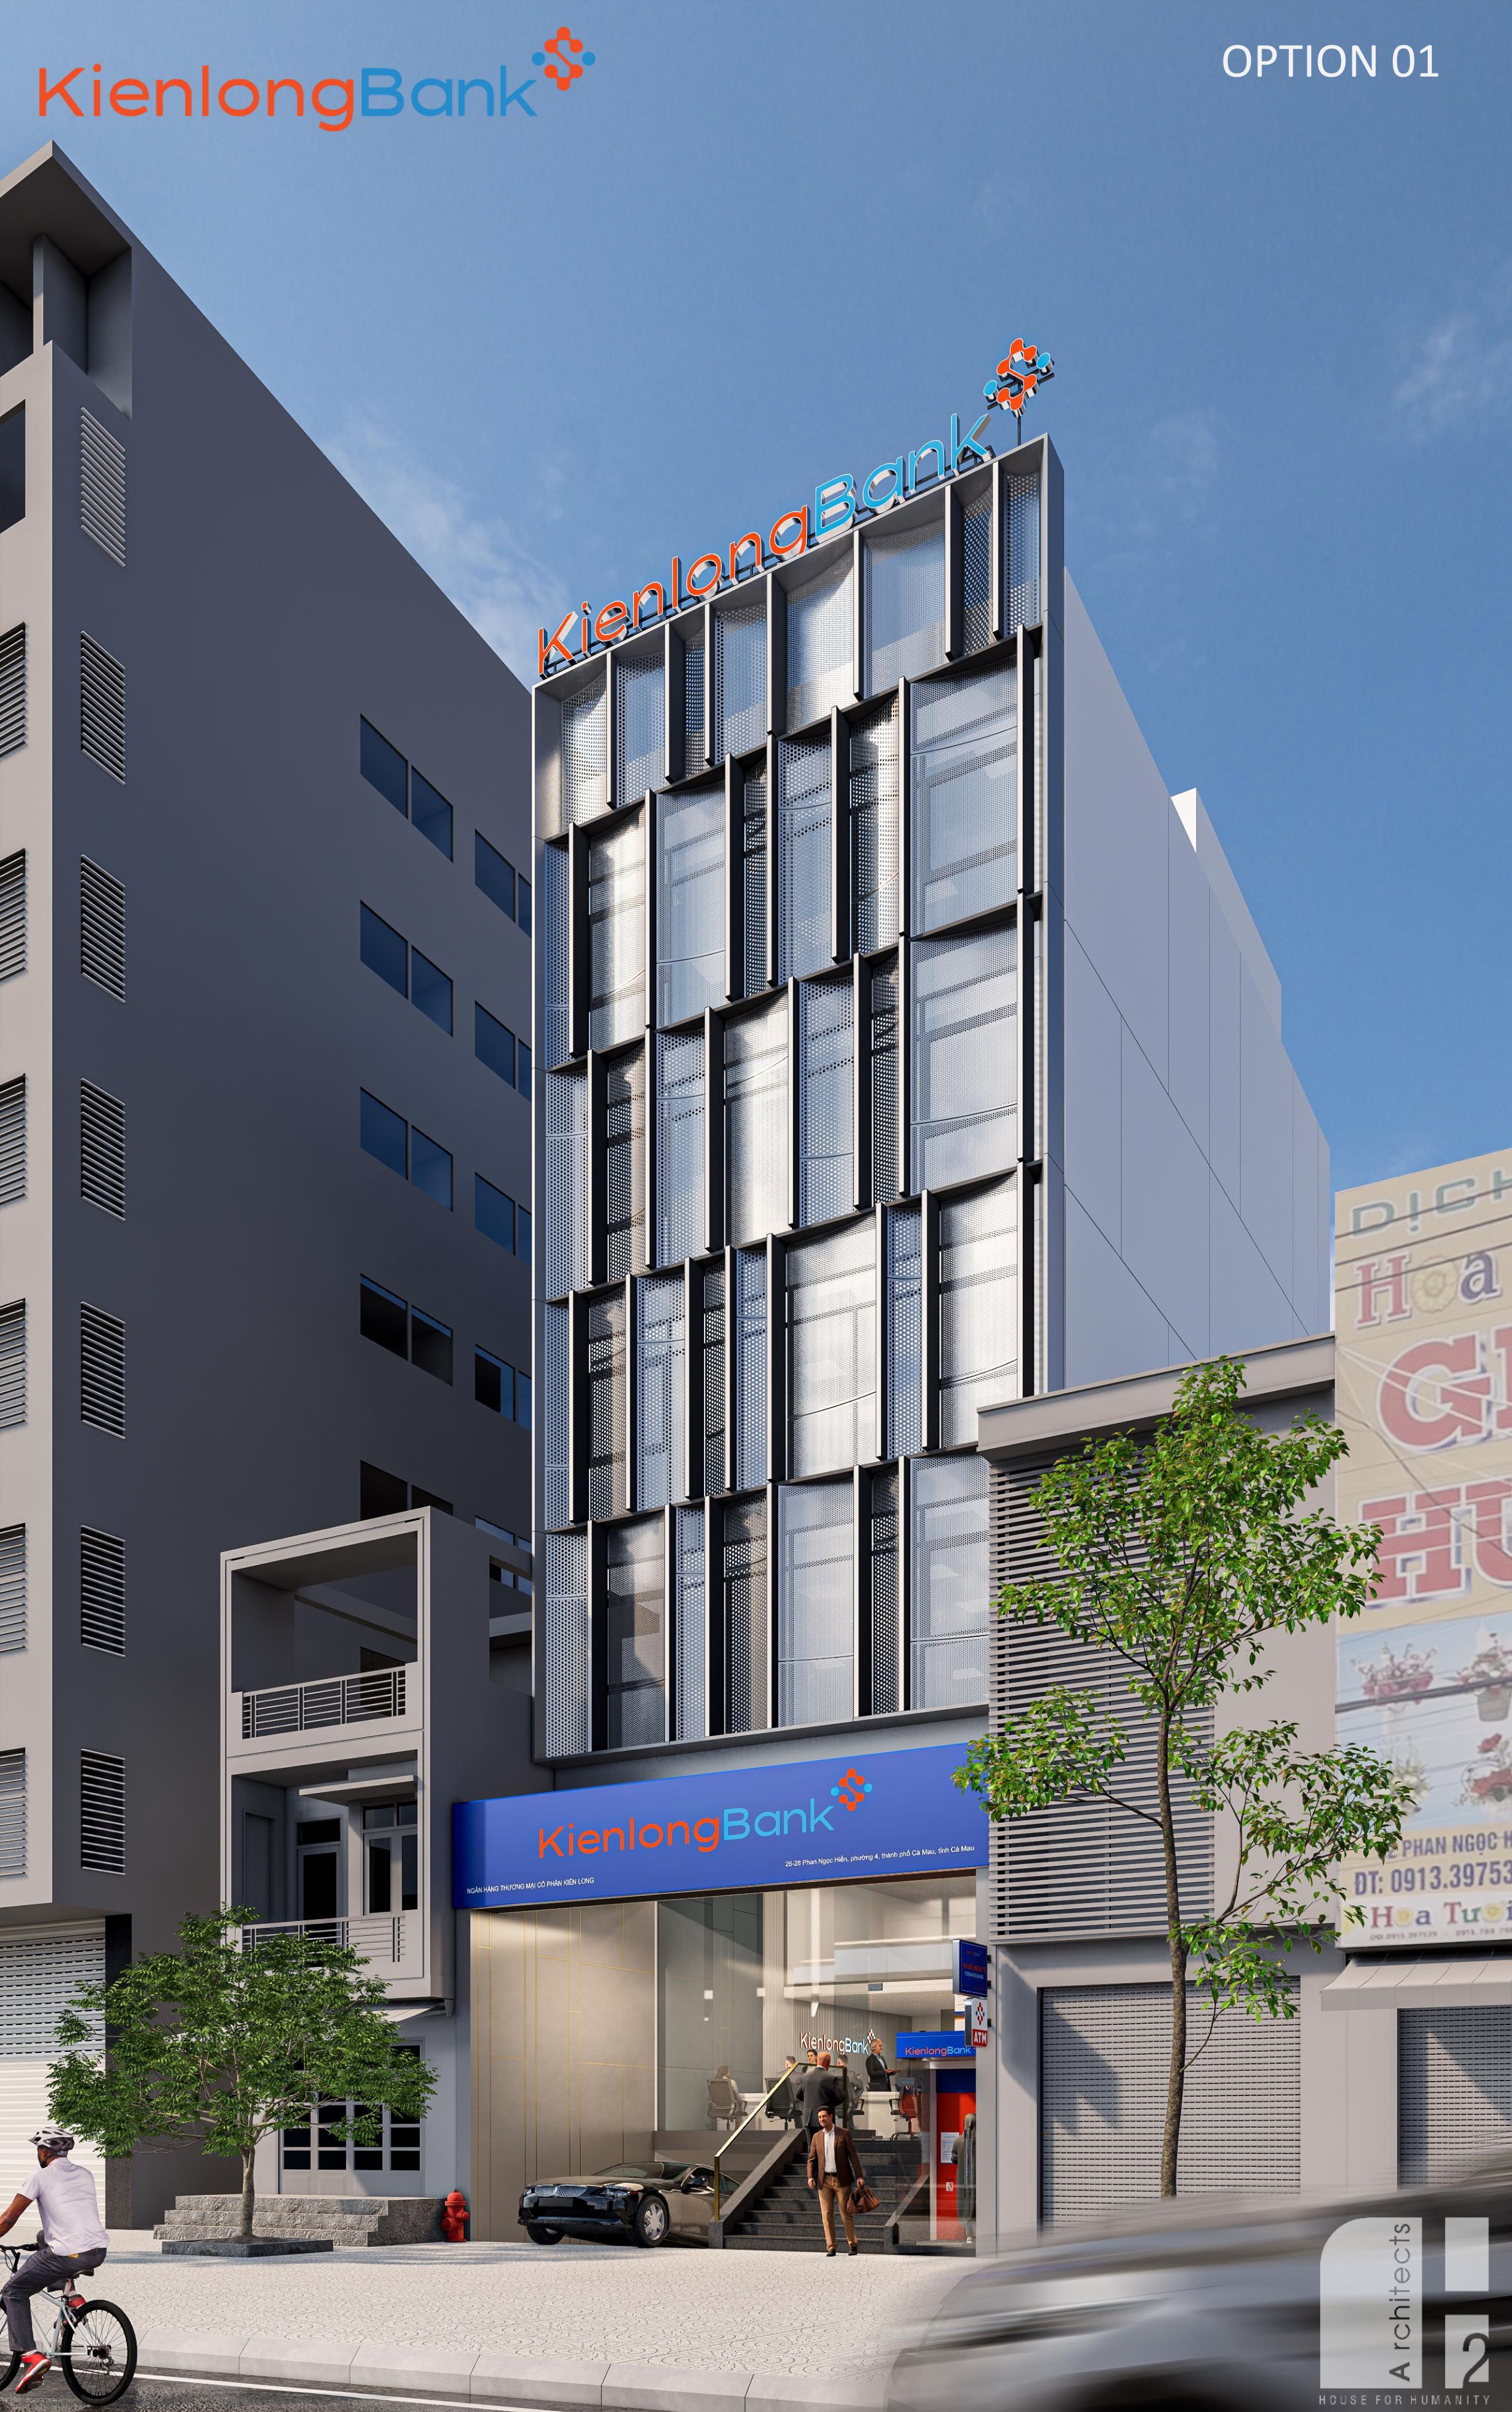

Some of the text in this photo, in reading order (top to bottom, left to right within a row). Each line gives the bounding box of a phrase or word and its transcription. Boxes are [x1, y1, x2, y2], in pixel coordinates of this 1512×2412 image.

[538, 413, 993, 676] KienlongBank
[539, 1798, 834, 1859] KienlongBank
[900, 1850, 910, 1858] phố
[1403, 1837, 1446, 1857] PHAN
[1453, 1832, 1498, 1856] NGỌC
[526, 1882, 536, 1890] MẠI
[1355, 1871, 1383, 1896] ĐT:
[800, 2032, 868, 2055] KienlongBank
[974, 2031, 986, 2044] ATM
[905, 2046, 971, 2057] KienlongBank
